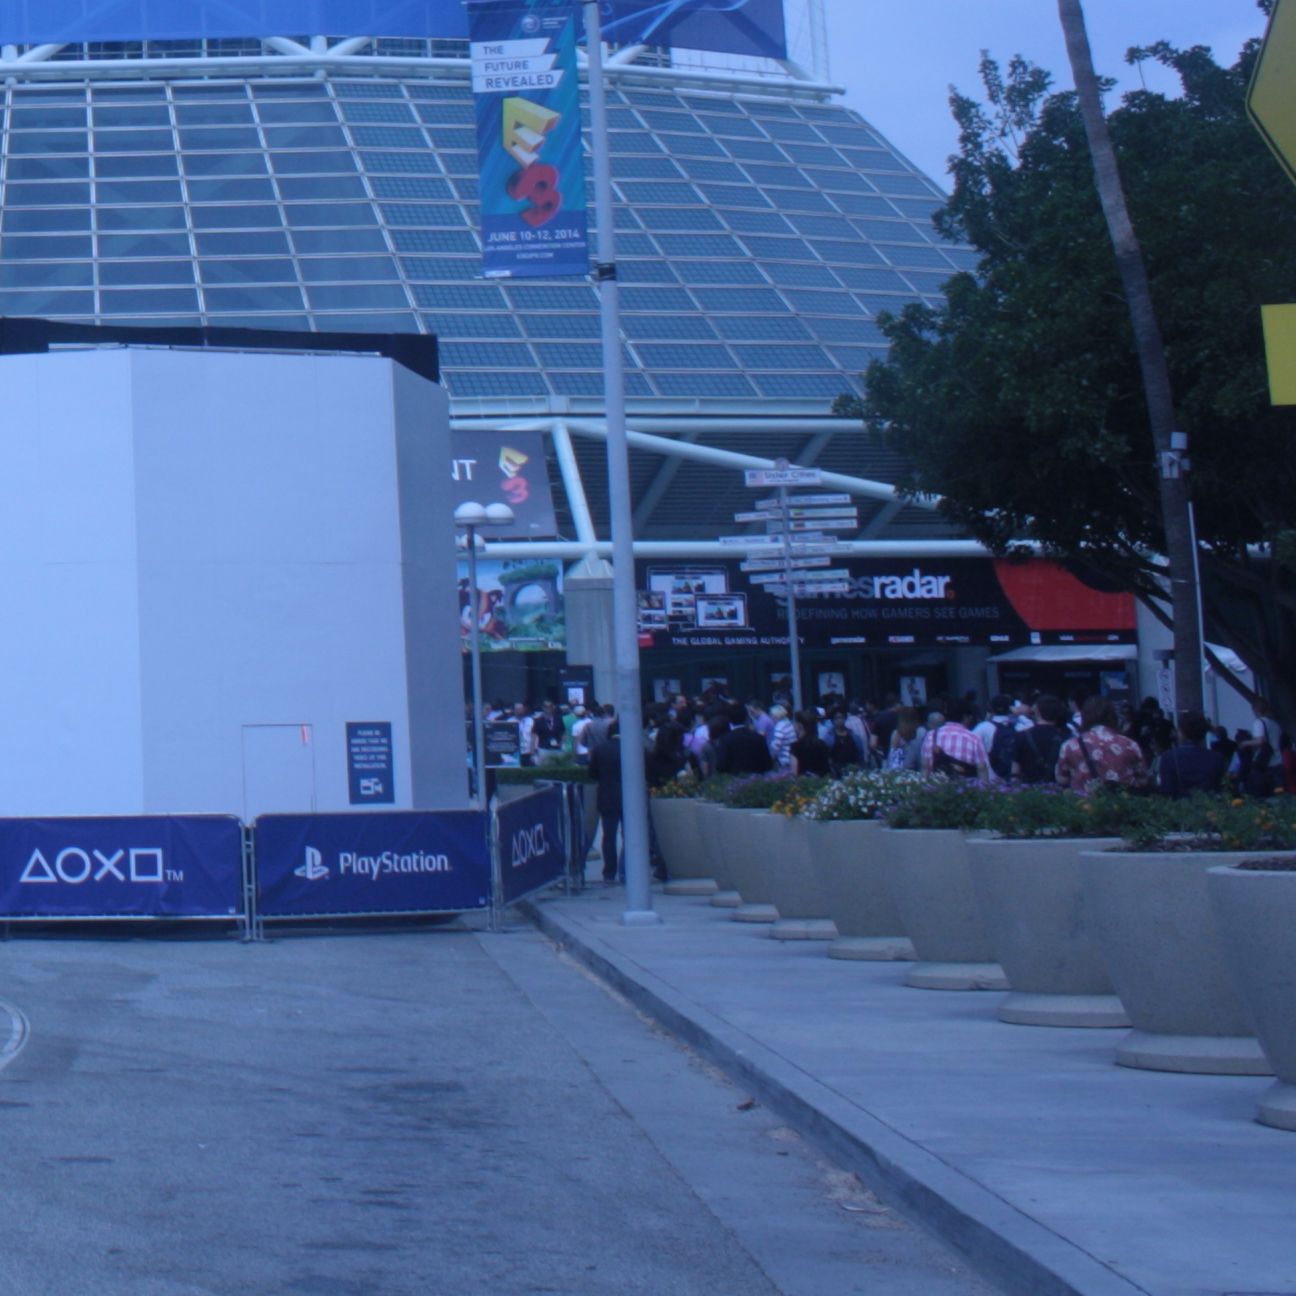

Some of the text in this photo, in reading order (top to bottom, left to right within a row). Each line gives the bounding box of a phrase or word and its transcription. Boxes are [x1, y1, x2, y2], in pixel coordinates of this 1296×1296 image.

[483, 44, 504, 55] THE
[484, 60, 529, 72] FUTURE
[485, 74, 554, 89] REVEALED
[487, 231, 517, 242] JUNE
[554, 228, 580, 240] 2014
[777, 607, 1000, 620] RDEFINING HOW GAMERS SEE GAMES
[338, 851, 449, 880] PlayStation
